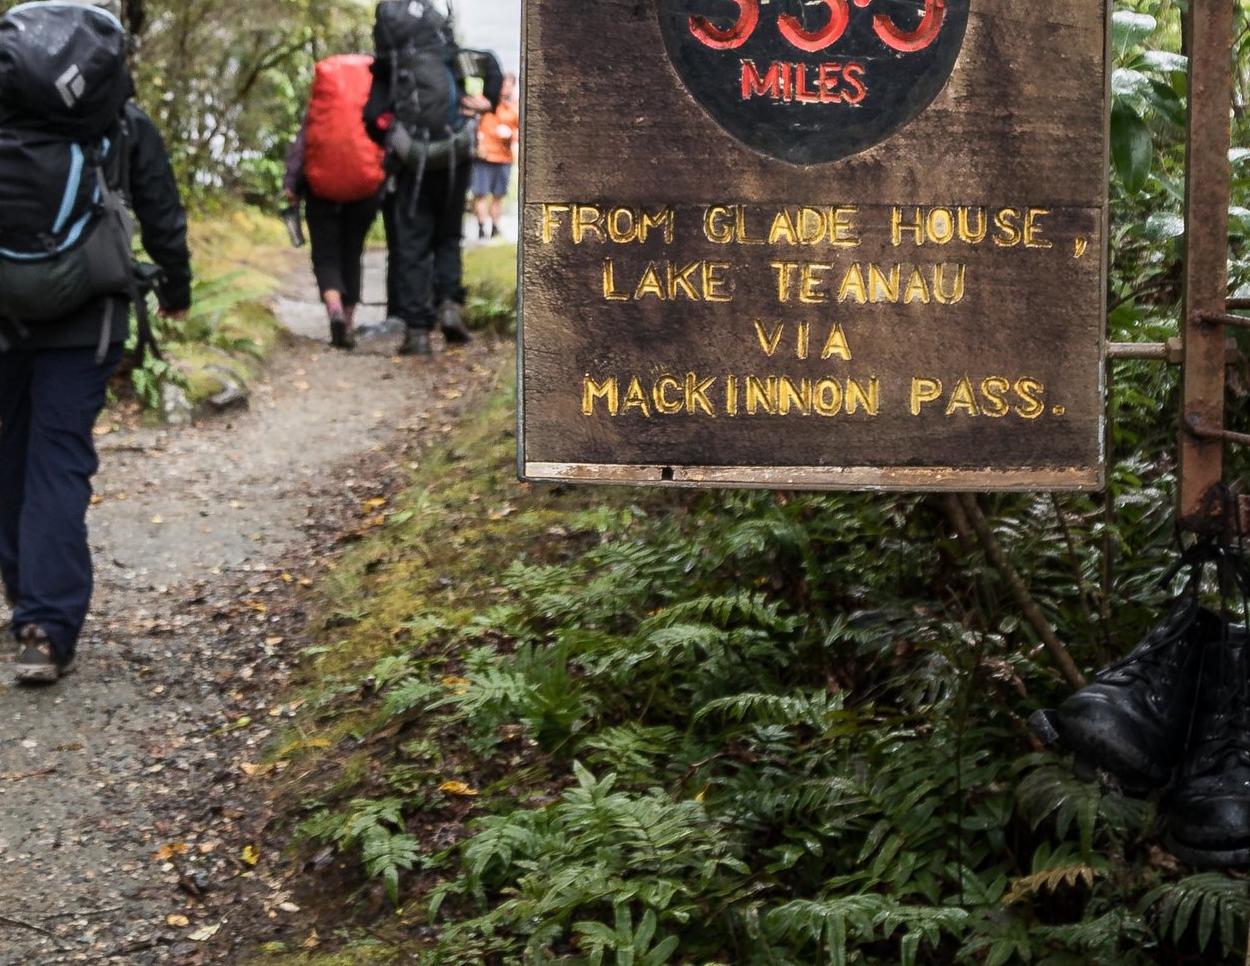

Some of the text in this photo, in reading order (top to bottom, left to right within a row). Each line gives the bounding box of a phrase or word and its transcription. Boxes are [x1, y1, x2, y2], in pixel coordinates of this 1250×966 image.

[739, 60, 867, 104] MILES
[541, 203, 674, 245] FROM
[703, 204, 861, 248] GLADE
[601, 259, 734, 303] LAKE
[754, 319, 853, 361] VIA
[581, 372, 1066, 419] MACKINNON PASS.
